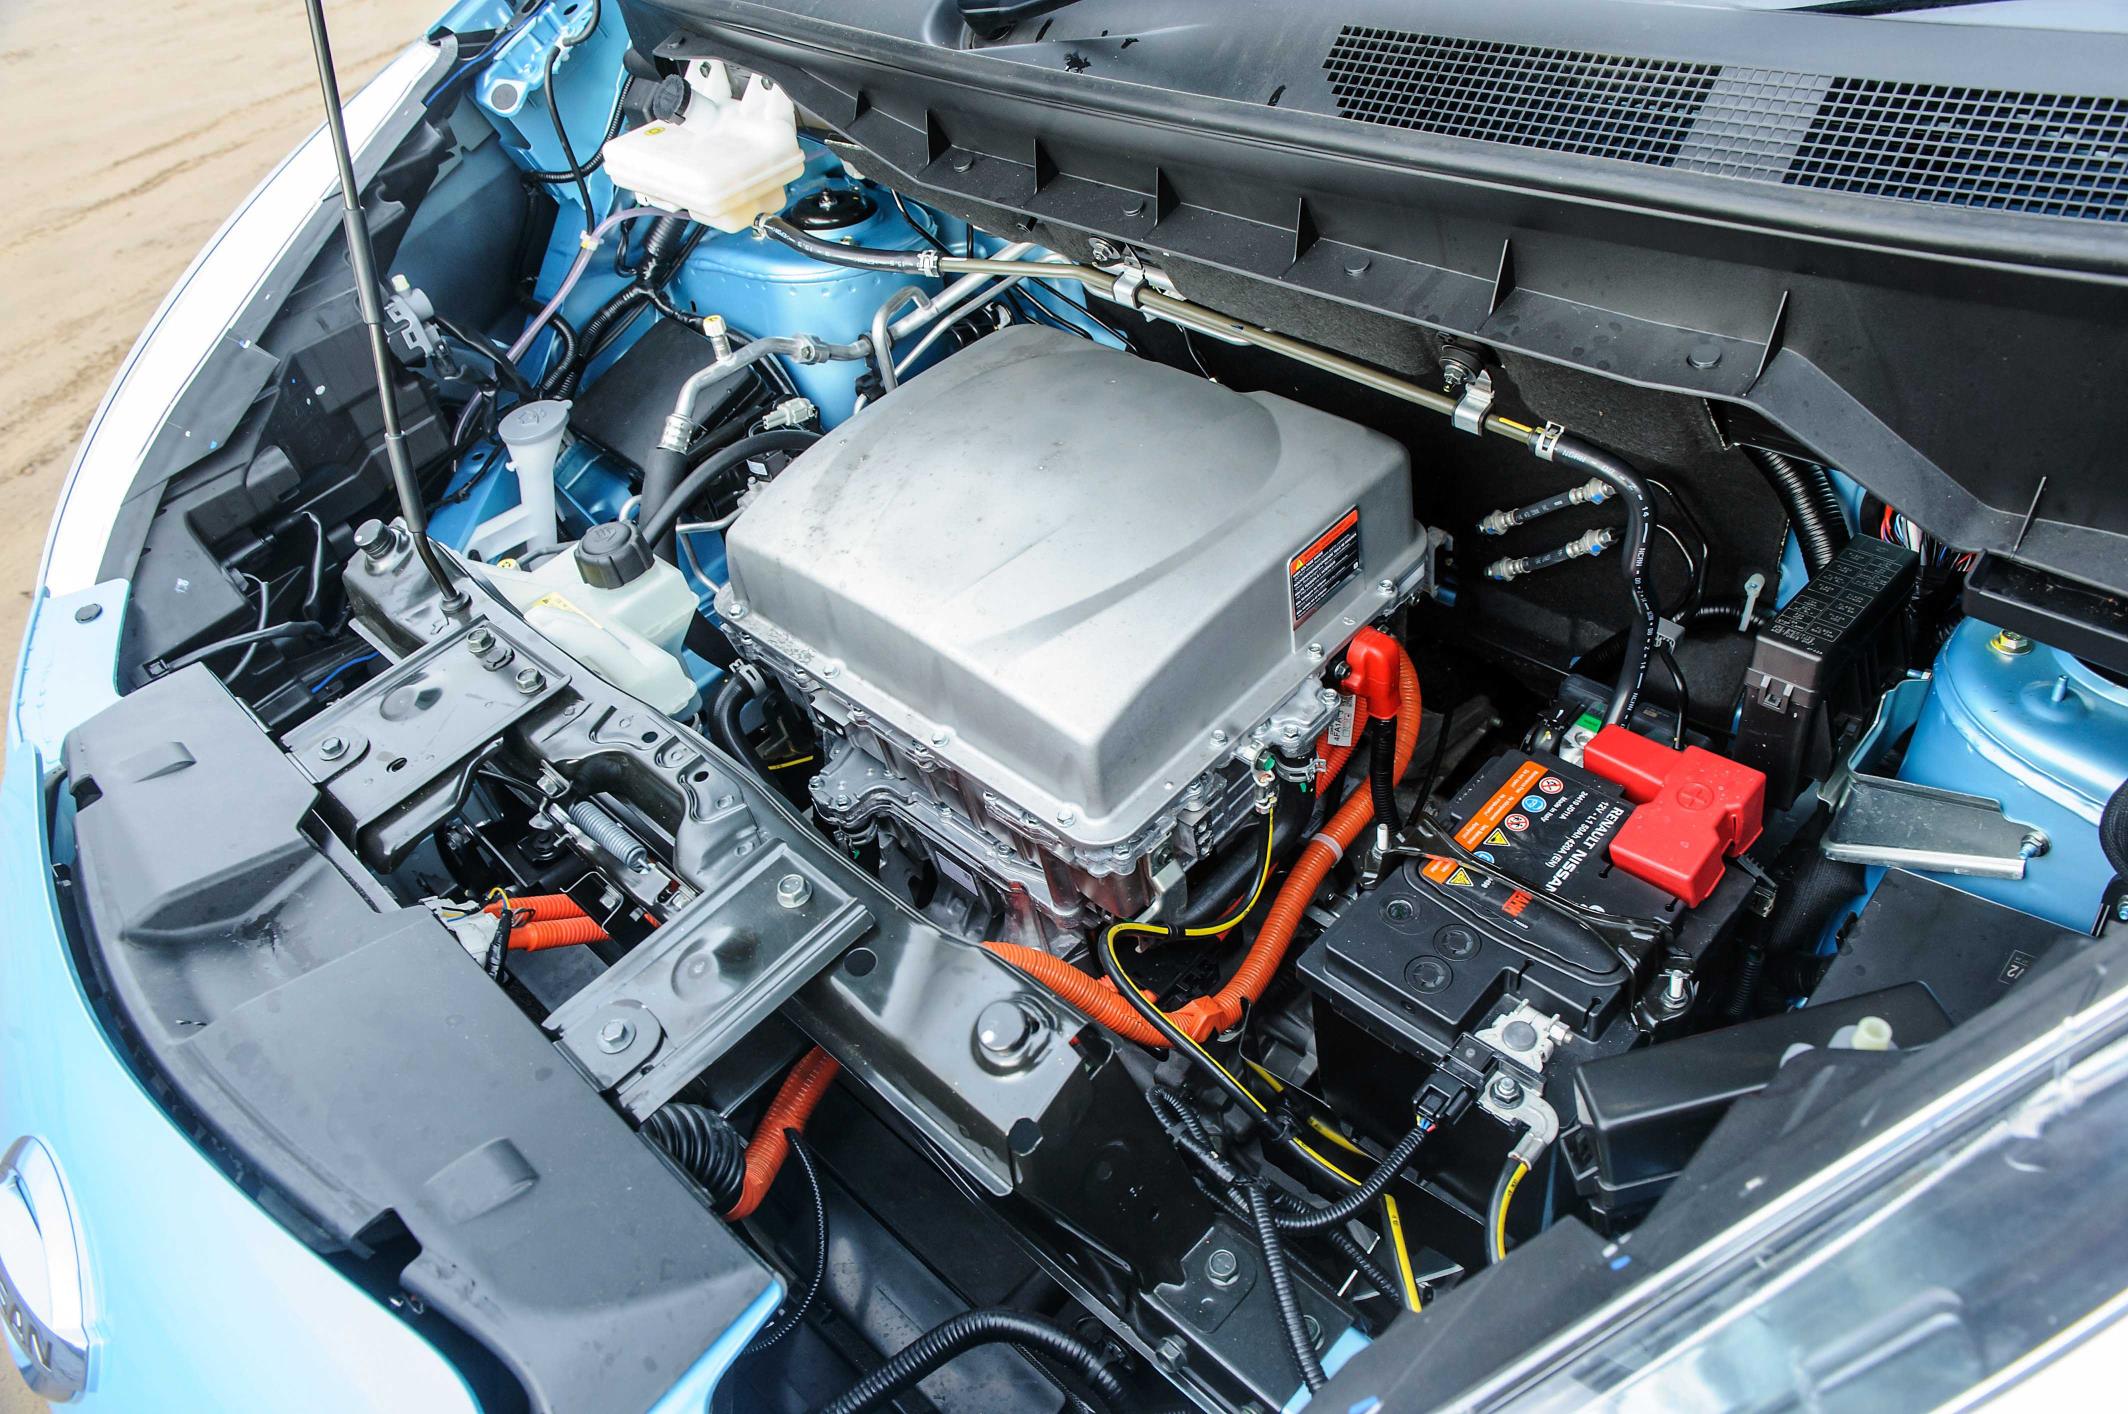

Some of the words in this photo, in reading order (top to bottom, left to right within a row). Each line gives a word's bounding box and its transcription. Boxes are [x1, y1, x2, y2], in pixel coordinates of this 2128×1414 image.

[1552, 795, 1568, 809] Made
[1595, 800, 1609, 814] 12V
[1539, 810, 1555, 823] Italy
[1584, 814, 1597, 825] L1
[1571, 822, 1589, 841] 50Ah
[1582, 805, 1624, 850] RENAULT
[1557, 837, 1576, 855] 420A
[1544, 851, 1562, 869] (EN)
